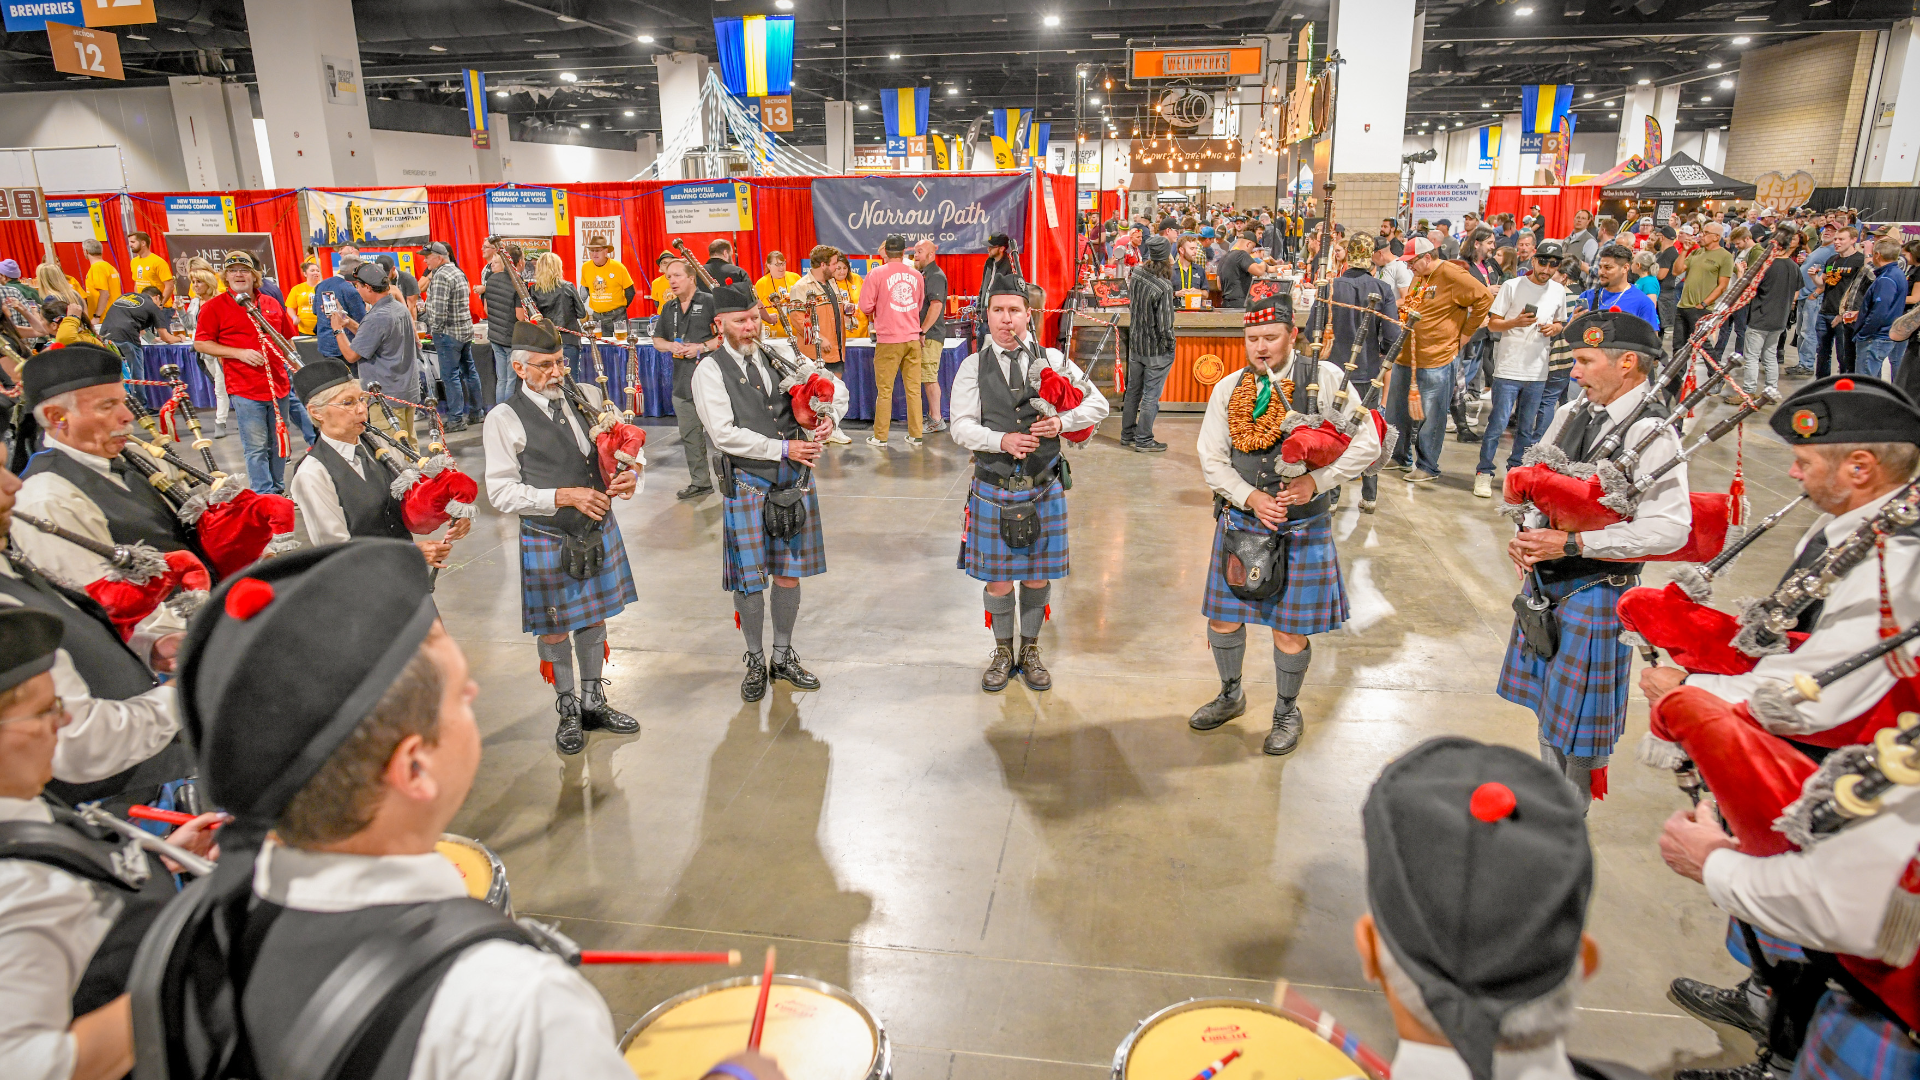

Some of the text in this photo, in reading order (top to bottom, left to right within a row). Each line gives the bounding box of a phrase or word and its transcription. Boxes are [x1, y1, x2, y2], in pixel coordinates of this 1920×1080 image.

[10, 2, 75, 17] BREWERIES
[73, 29, 95, 38] SECTION
[74, 41, 105, 72] 12
[1167, 54, 1228, 71] WELDWERKS
[765, 107, 788, 126] 13
[888, 140, 924, 154] P-S 14
[1521, 137, 1557, 151] H-K 9
[1135, 152, 1183, 160] WEDWEKS
[1070, 164, 1097, 172] MTTERS
[1756, 174, 1813, 197] BEER
[1756, 196, 1803, 211] LOVE
[363, 206, 427, 216] NEW HELVETIA
[848, 200, 991, 230] Narrow Path
[581, 220, 616, 229] NEBRASKA'S
[887, 232, 957, 242] EWING CO.
